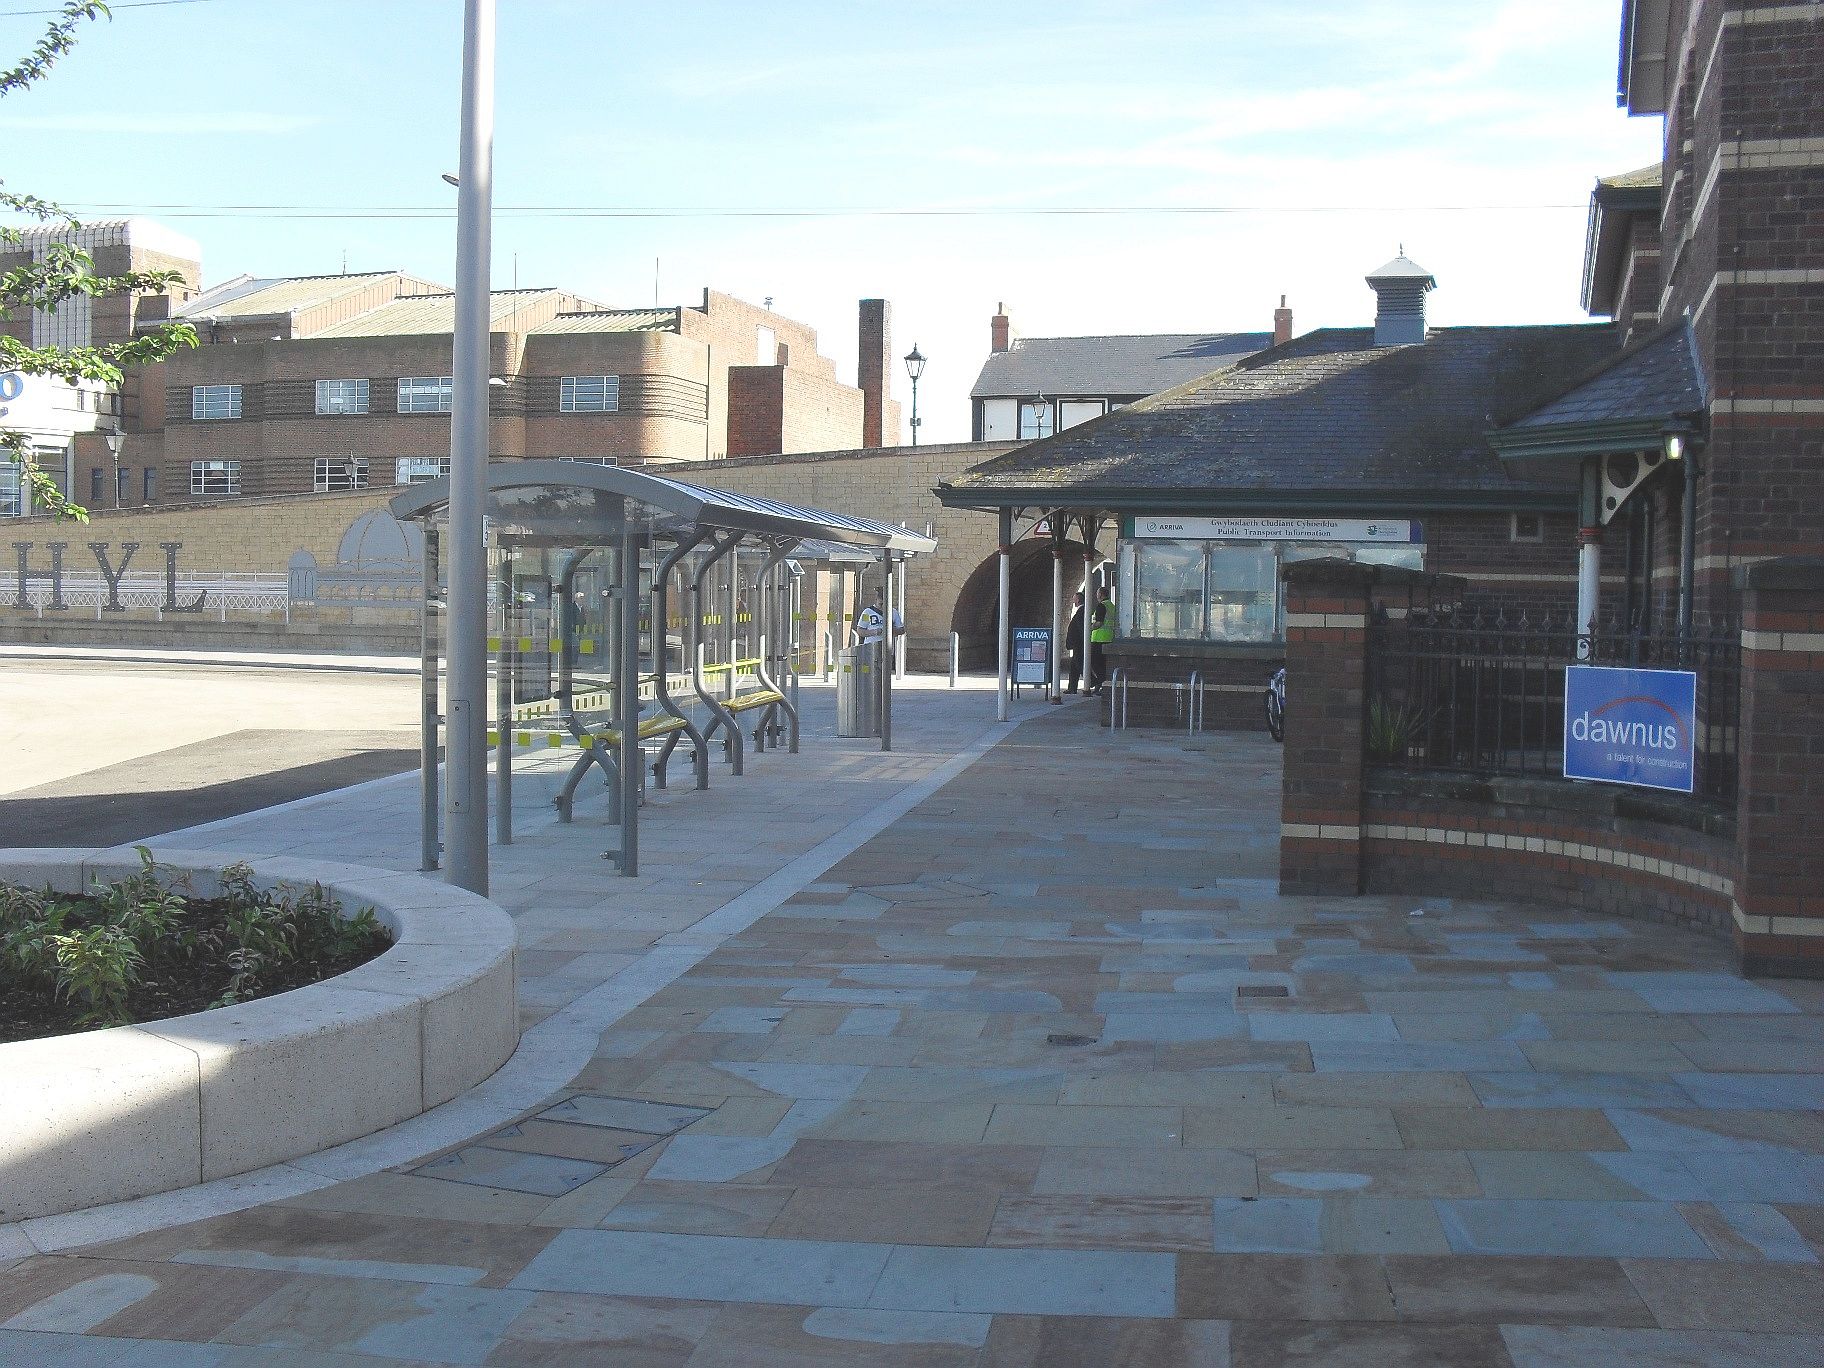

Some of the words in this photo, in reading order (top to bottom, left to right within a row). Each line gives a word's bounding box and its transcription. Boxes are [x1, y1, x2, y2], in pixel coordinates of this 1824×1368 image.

[1261, 519, 1294, 528] Cludiant
[1217, 528, 1240, 536] Public
[1244, 528, 1281, 537] Transport
[1285, 529, 1331, 537] Information
[1016, 631, 1049, 640] ARRIVA
[1572, 711, 1677, 750] dawnus
[1614, 753, 1634, 763] talent
[1636, 755, 1645, 764] for
[1647, 757, 1688, 770] construction
